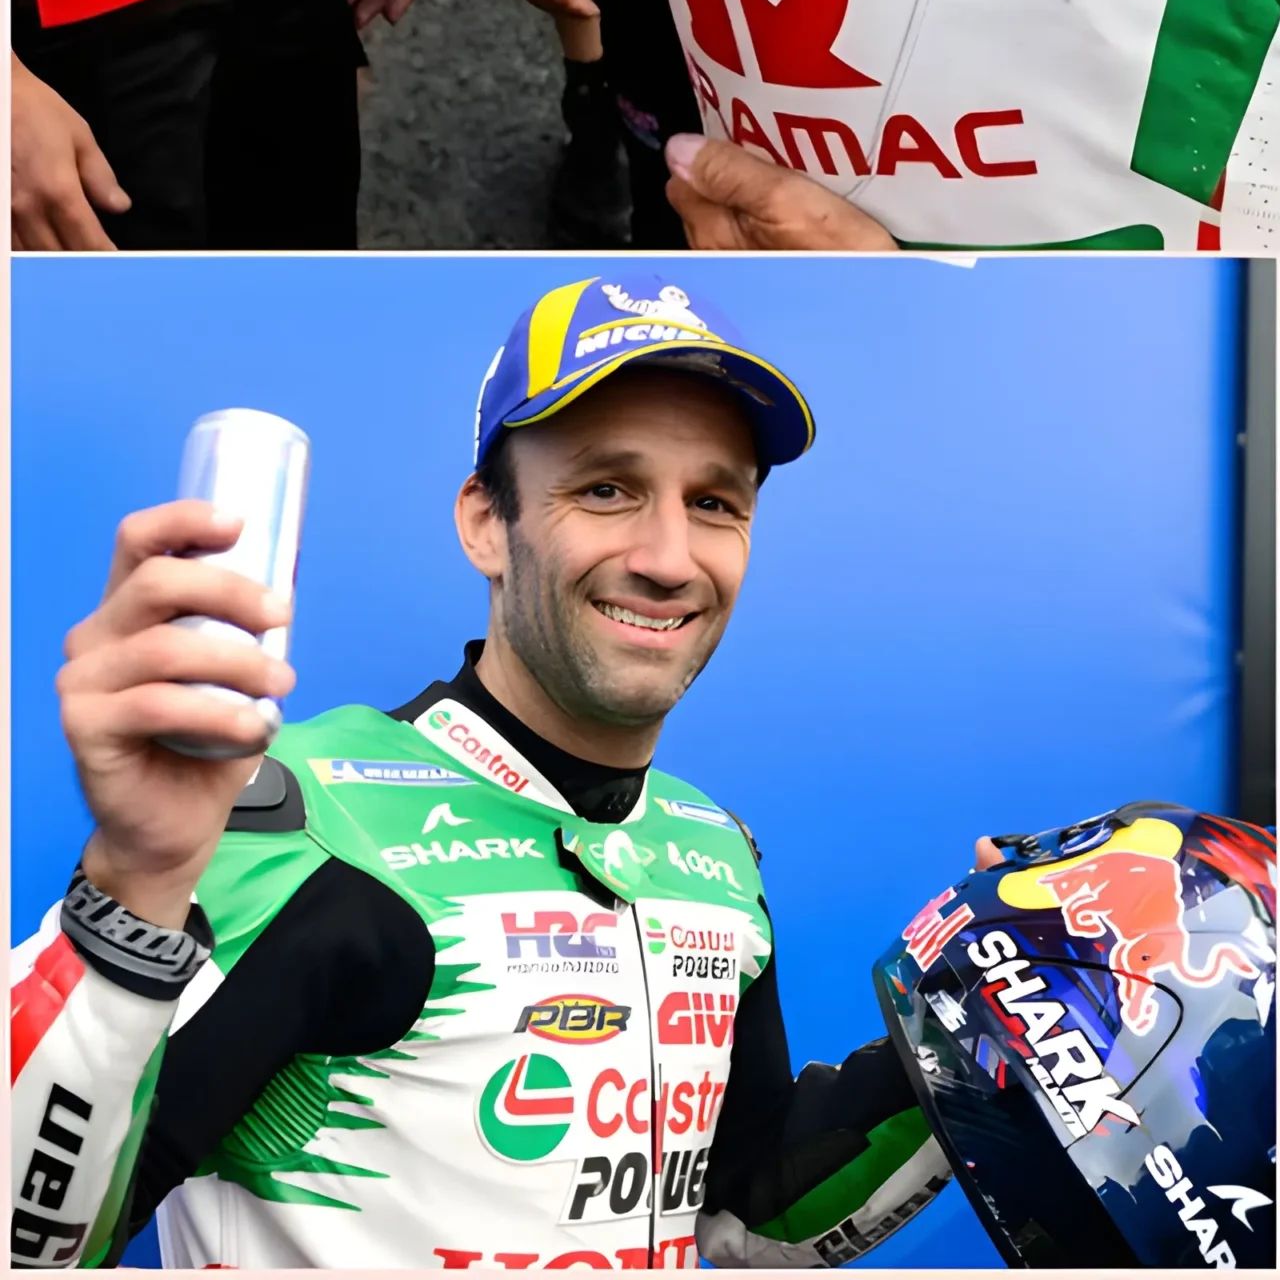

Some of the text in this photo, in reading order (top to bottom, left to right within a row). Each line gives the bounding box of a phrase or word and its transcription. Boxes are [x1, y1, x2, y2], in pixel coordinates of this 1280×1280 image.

[688, 48, 1039, 180] RAMAC
[448, 723, 530, 794] Castrol
[380, 836, 546, 871] SHARK
[501, 911, 618, 958] HRC
[967, 929, 1141, 1134] SHARK
